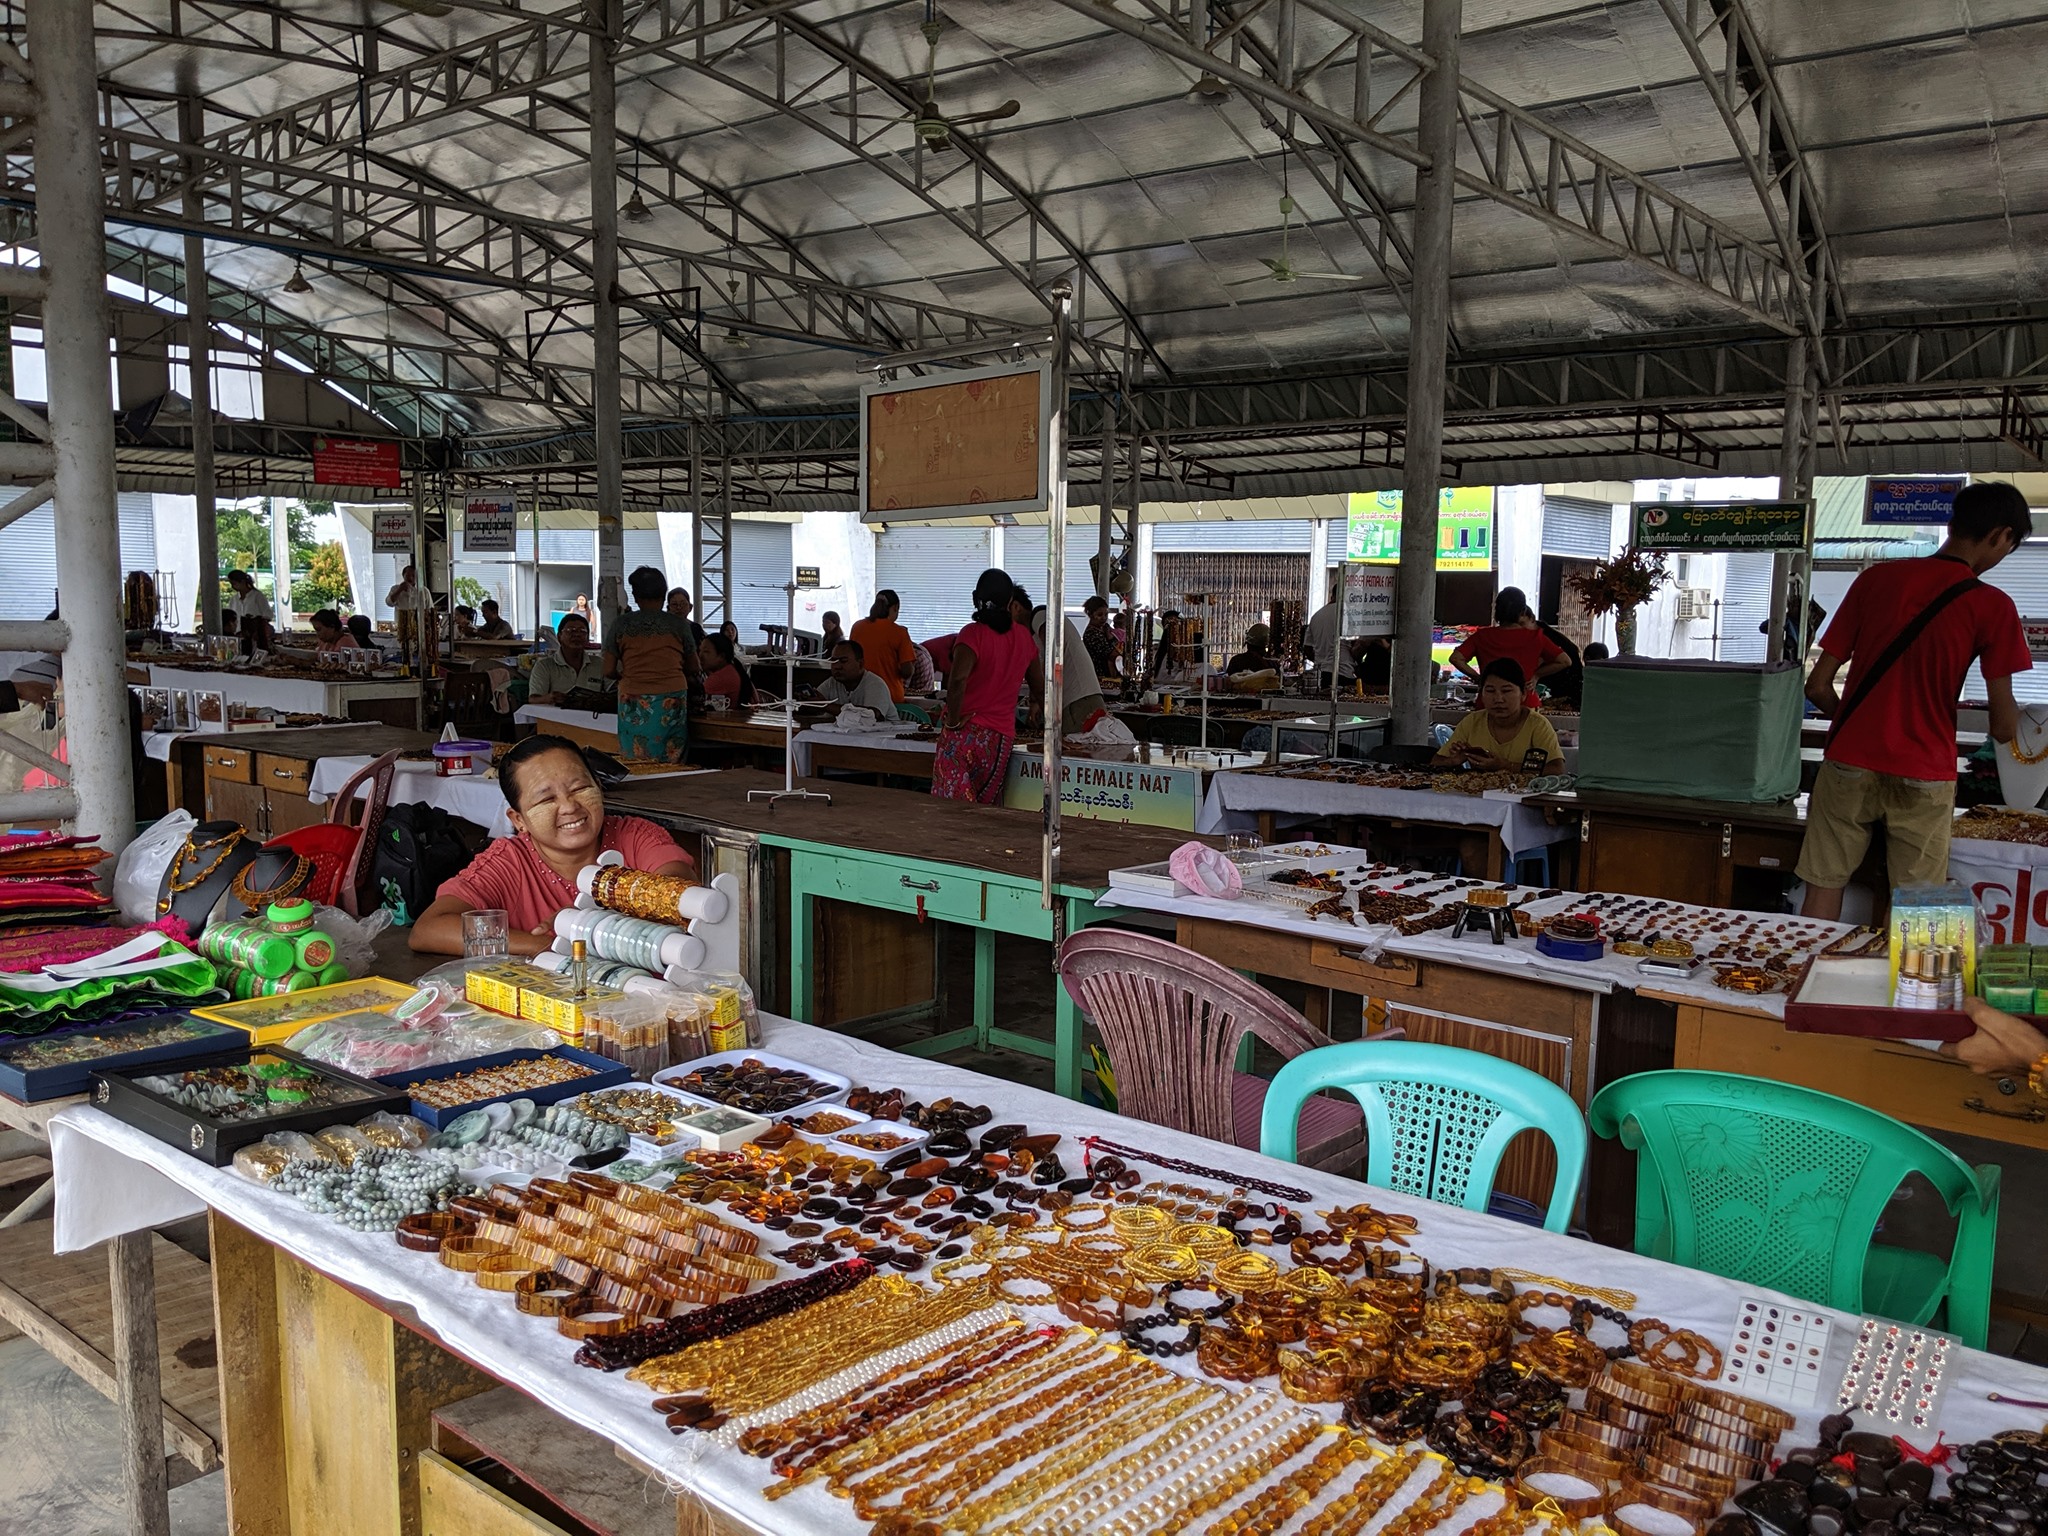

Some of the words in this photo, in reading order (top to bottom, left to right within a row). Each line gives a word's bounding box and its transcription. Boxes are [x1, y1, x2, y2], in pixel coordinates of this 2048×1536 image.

[1349, 592, 1363, 603] Gems
[1019, 760, 1071, 783] AMR
[1076, 766, 1134, 790] FEMALE
[1139, 773, 1172, 795] NAT
[1060, 787, 1134, 811] ယင်းနတ်သမီး
